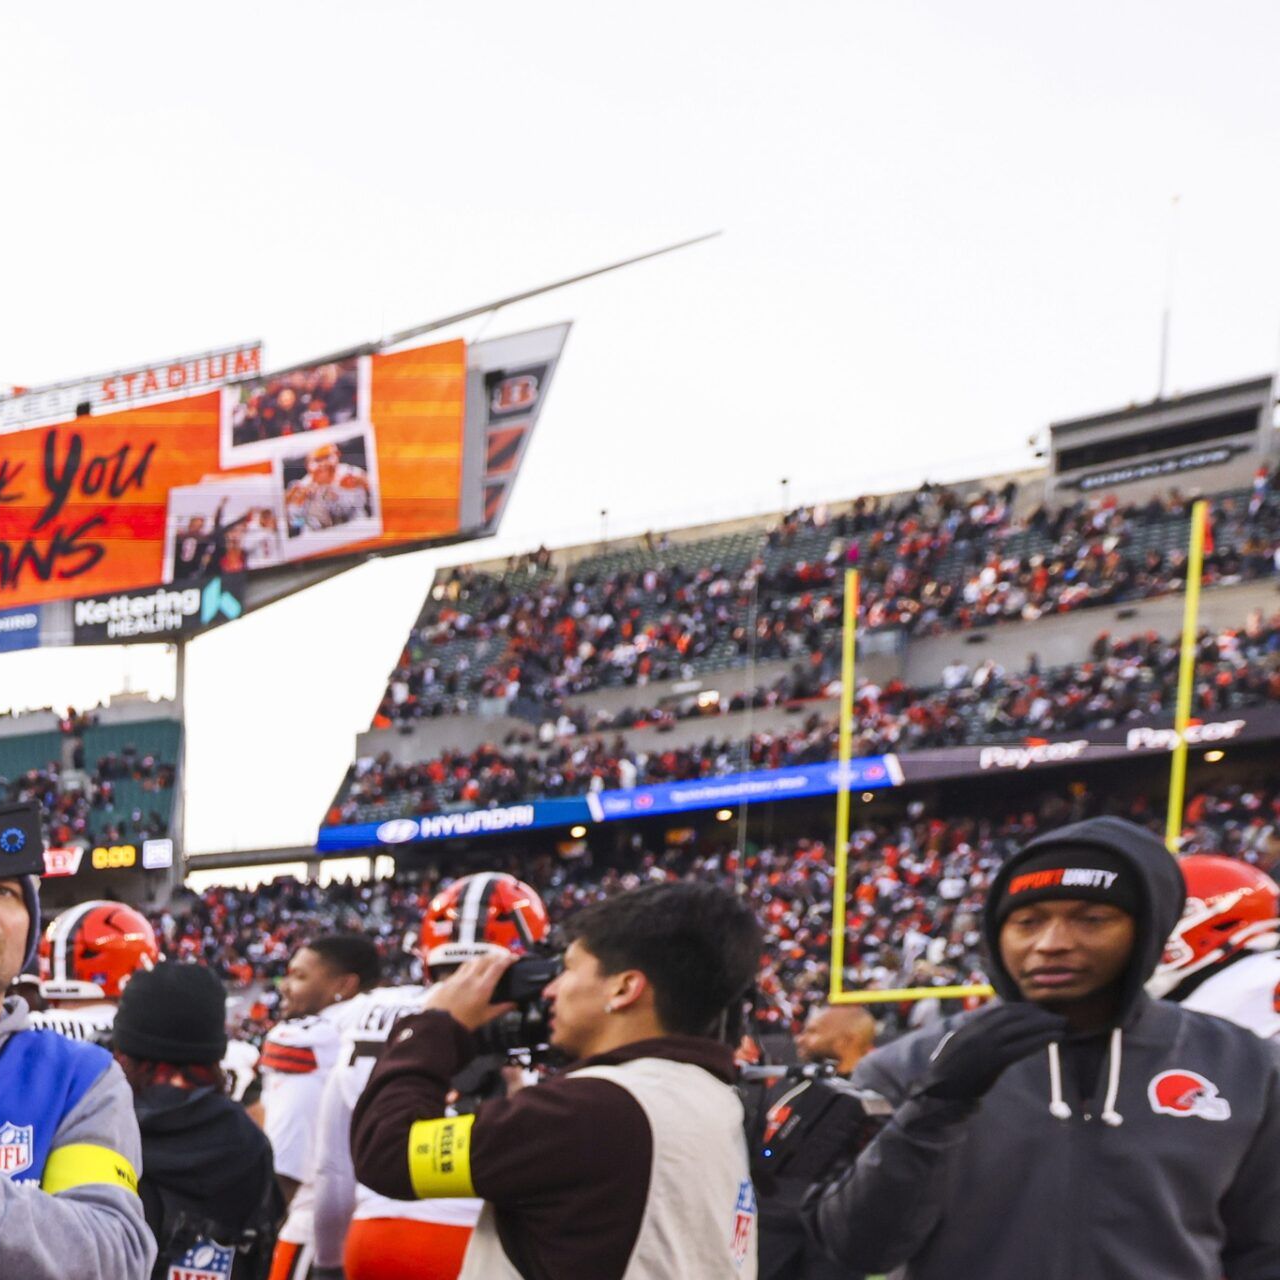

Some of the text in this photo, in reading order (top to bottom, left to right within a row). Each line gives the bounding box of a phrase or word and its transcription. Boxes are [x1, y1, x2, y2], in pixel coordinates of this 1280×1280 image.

[101, 346, 262, 401] STADIUM
[75, 588, 201, 626] Kettering
[107, 611, 182, 638] HEALTH
[1127, 719, 1246, 750] Paycor
[980, 739, 1089, 769] Paycor
[420, 804, 534, 838] HYUNDAI
